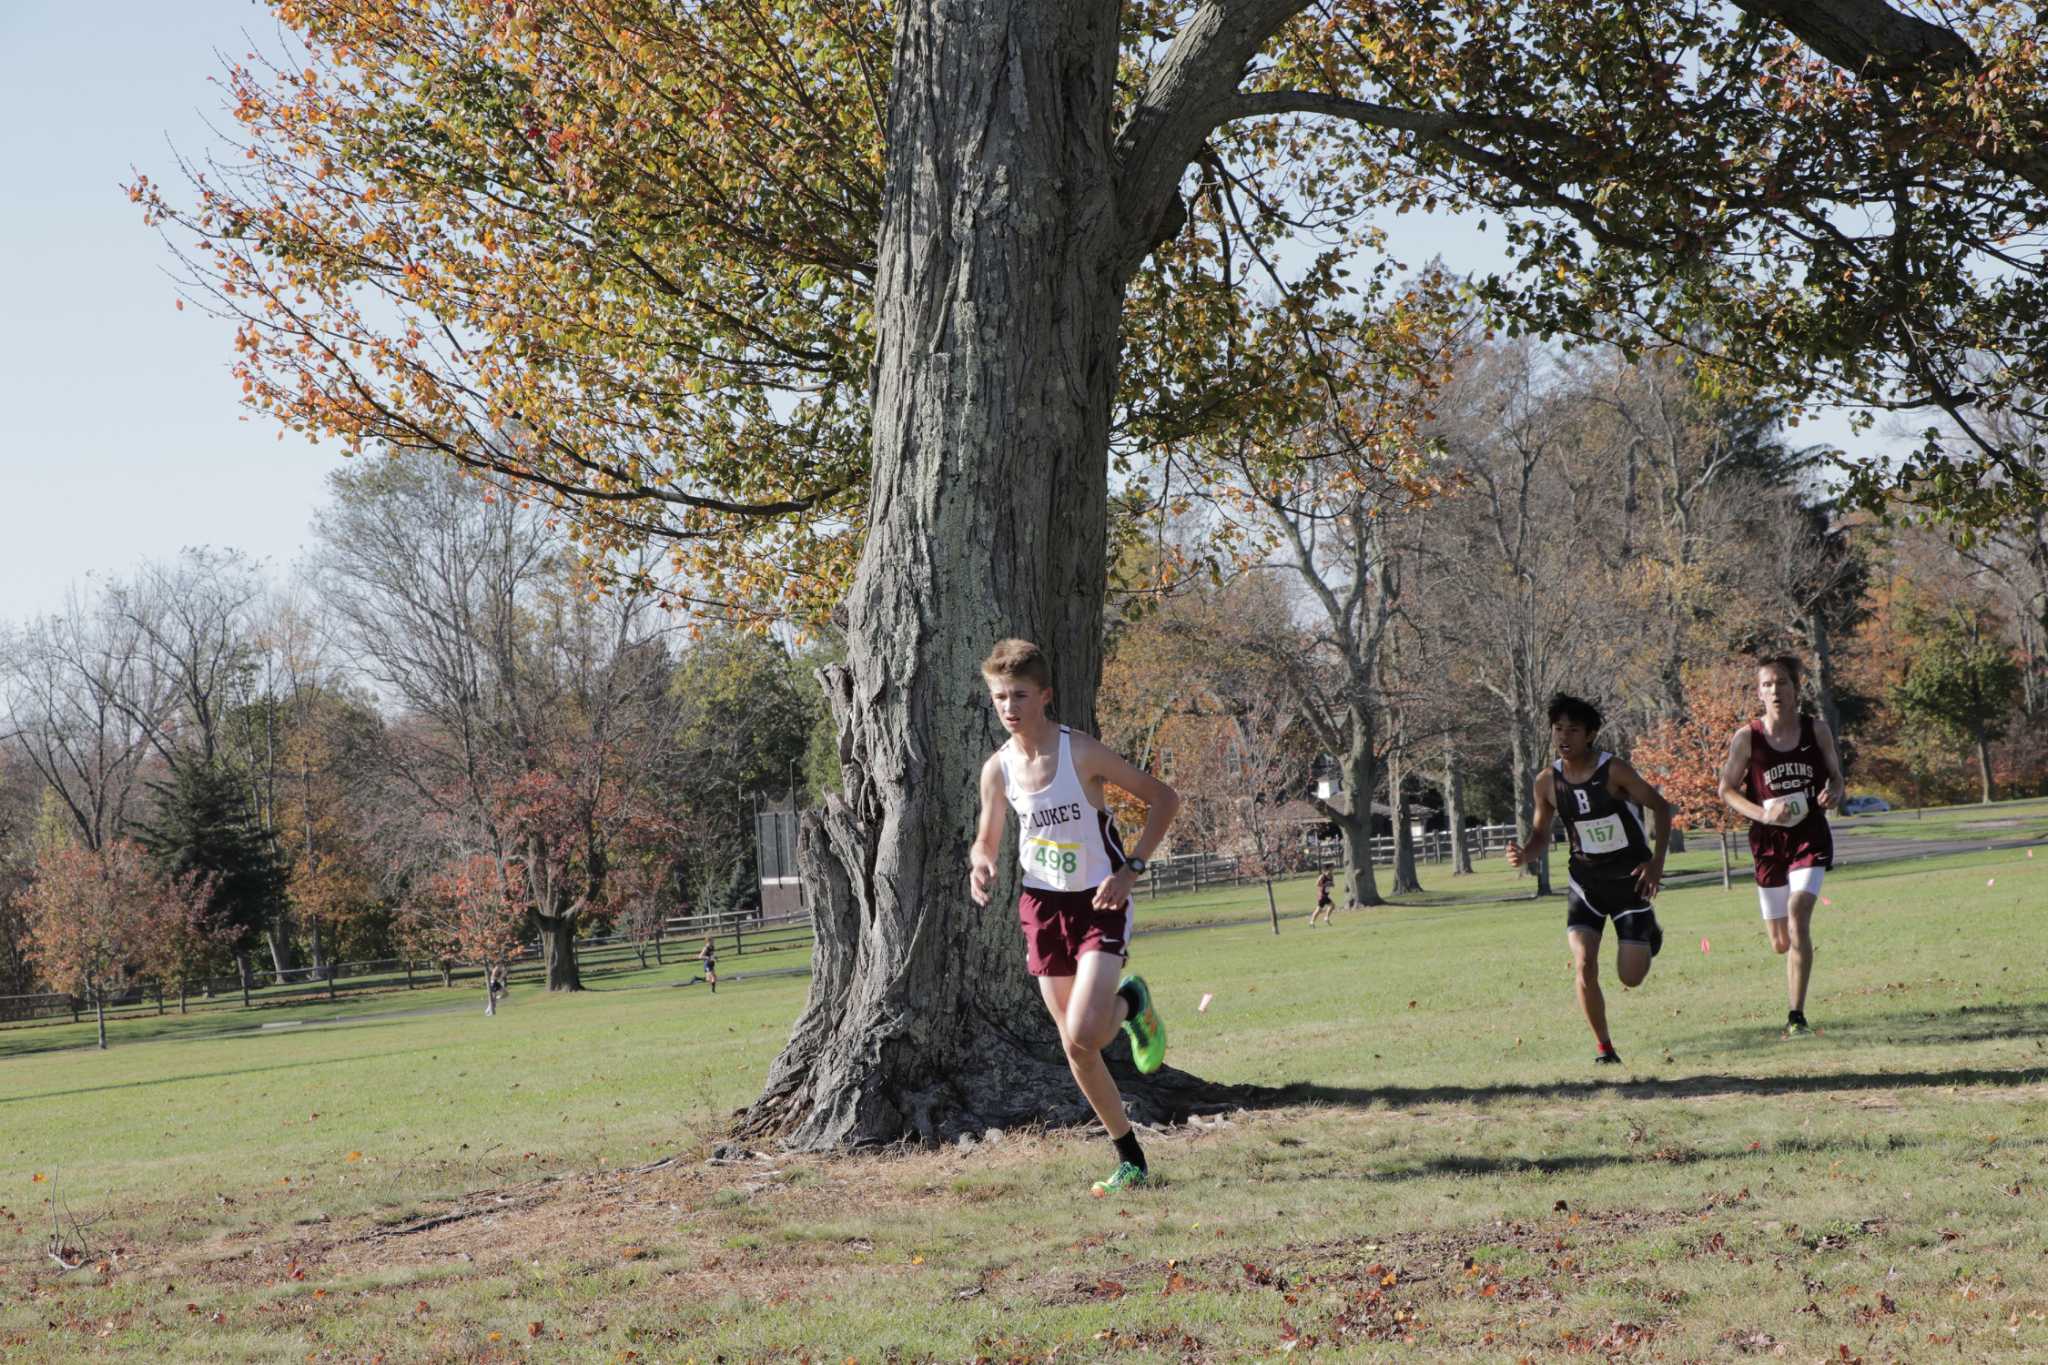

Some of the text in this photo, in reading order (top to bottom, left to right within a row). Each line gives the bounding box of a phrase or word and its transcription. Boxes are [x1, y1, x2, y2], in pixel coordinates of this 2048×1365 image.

[1763, 762, 1814, 785] HOPKINS
[1574, 789, 1591, 815] B
[1031, 803, 1081, 828] LUKE'S
[1586, 824, 1614, 843] 157
[1035, 847, 1078, 874] 498
